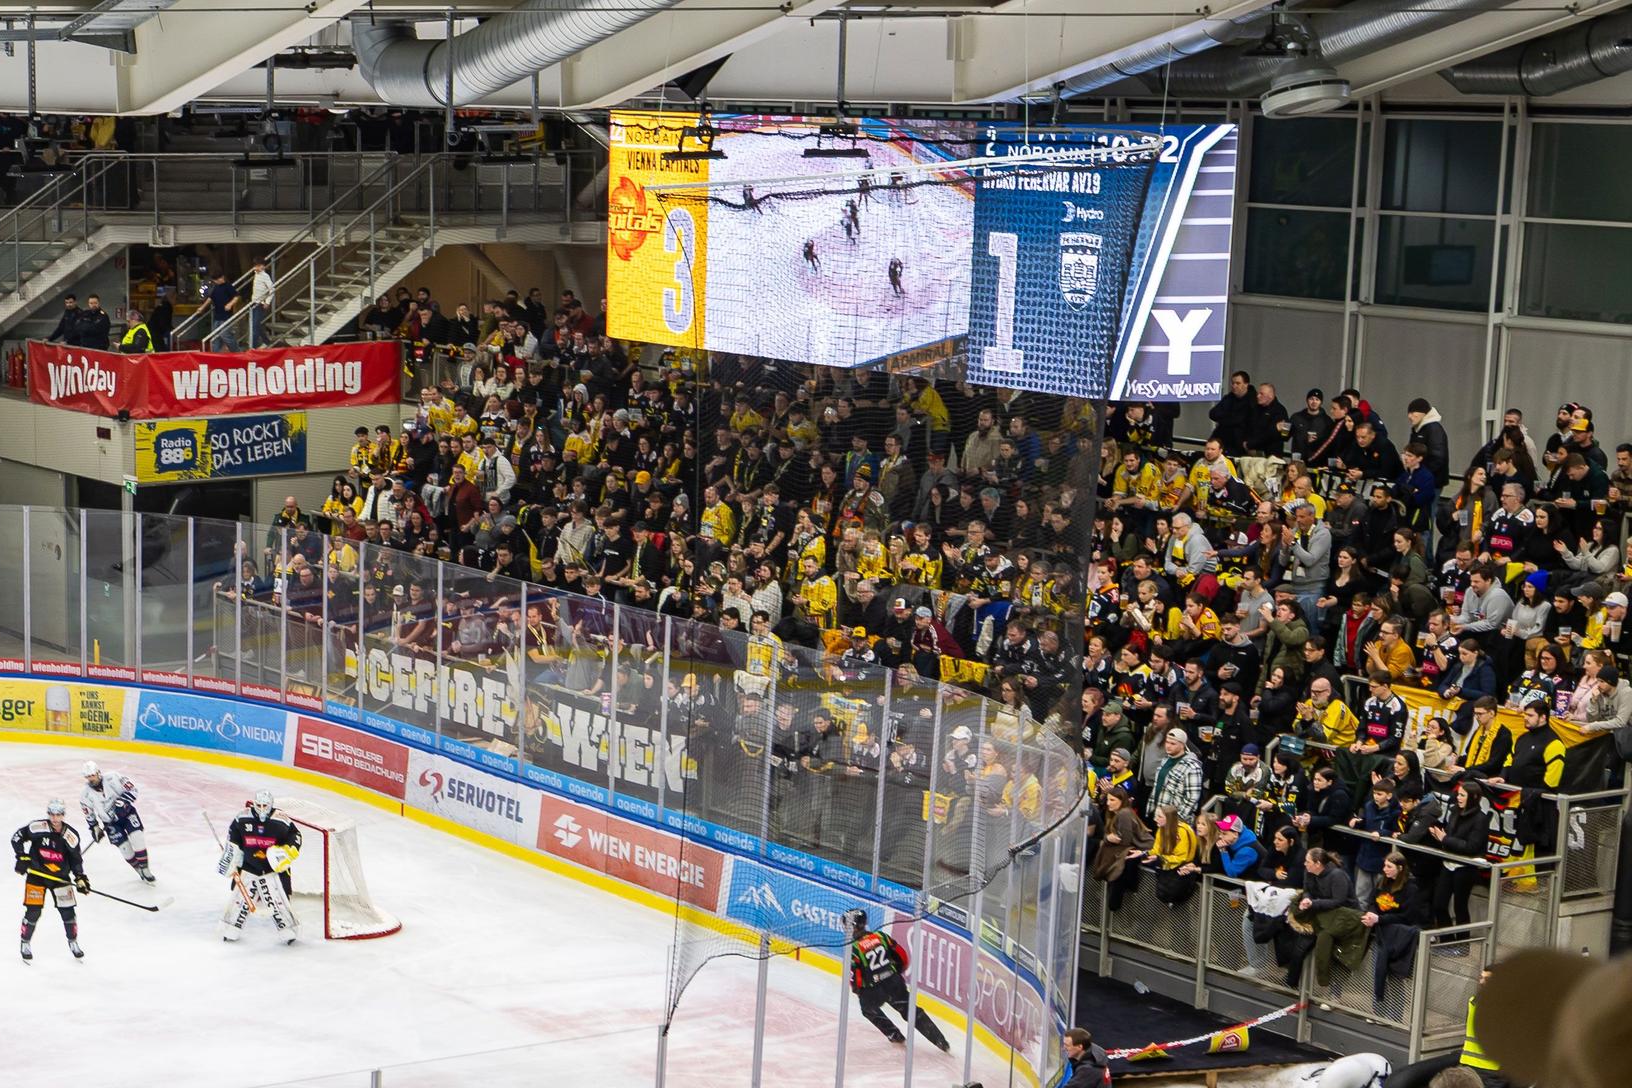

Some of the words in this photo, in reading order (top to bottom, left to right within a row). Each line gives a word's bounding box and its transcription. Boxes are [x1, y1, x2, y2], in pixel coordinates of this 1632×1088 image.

[627, 150, 657, 171] VIENNA
[663, 208, 696, 334] 3
[983, 231, 1024, 373] 1
[1151, 307, 1213, 375] Y
[160, 438, 192, 449] Radio
[211, 432, 230, 450] SO
[233, 420, 281, 446] ROCKT
[212, 450, 243, 470] DAS
[247, 437, 293, 464] LEBEN
[168, 714, 213, 733] NIEDAX
[242, 725, 284, 745] NIEDAX
[301, 732, 333, 760] SB
[334, 741, 384, 765] SPENGLEREI
[334, 753, 353, 767] UND
[354, 758, 405, 784] BEDACHUNG
[447, 778, 524, 823] SERVOTEL
[587, 828, 631, 863] WIEN
[634, 846, 705, 888] ENERGIE
[865, 945, 890, 971] 22
